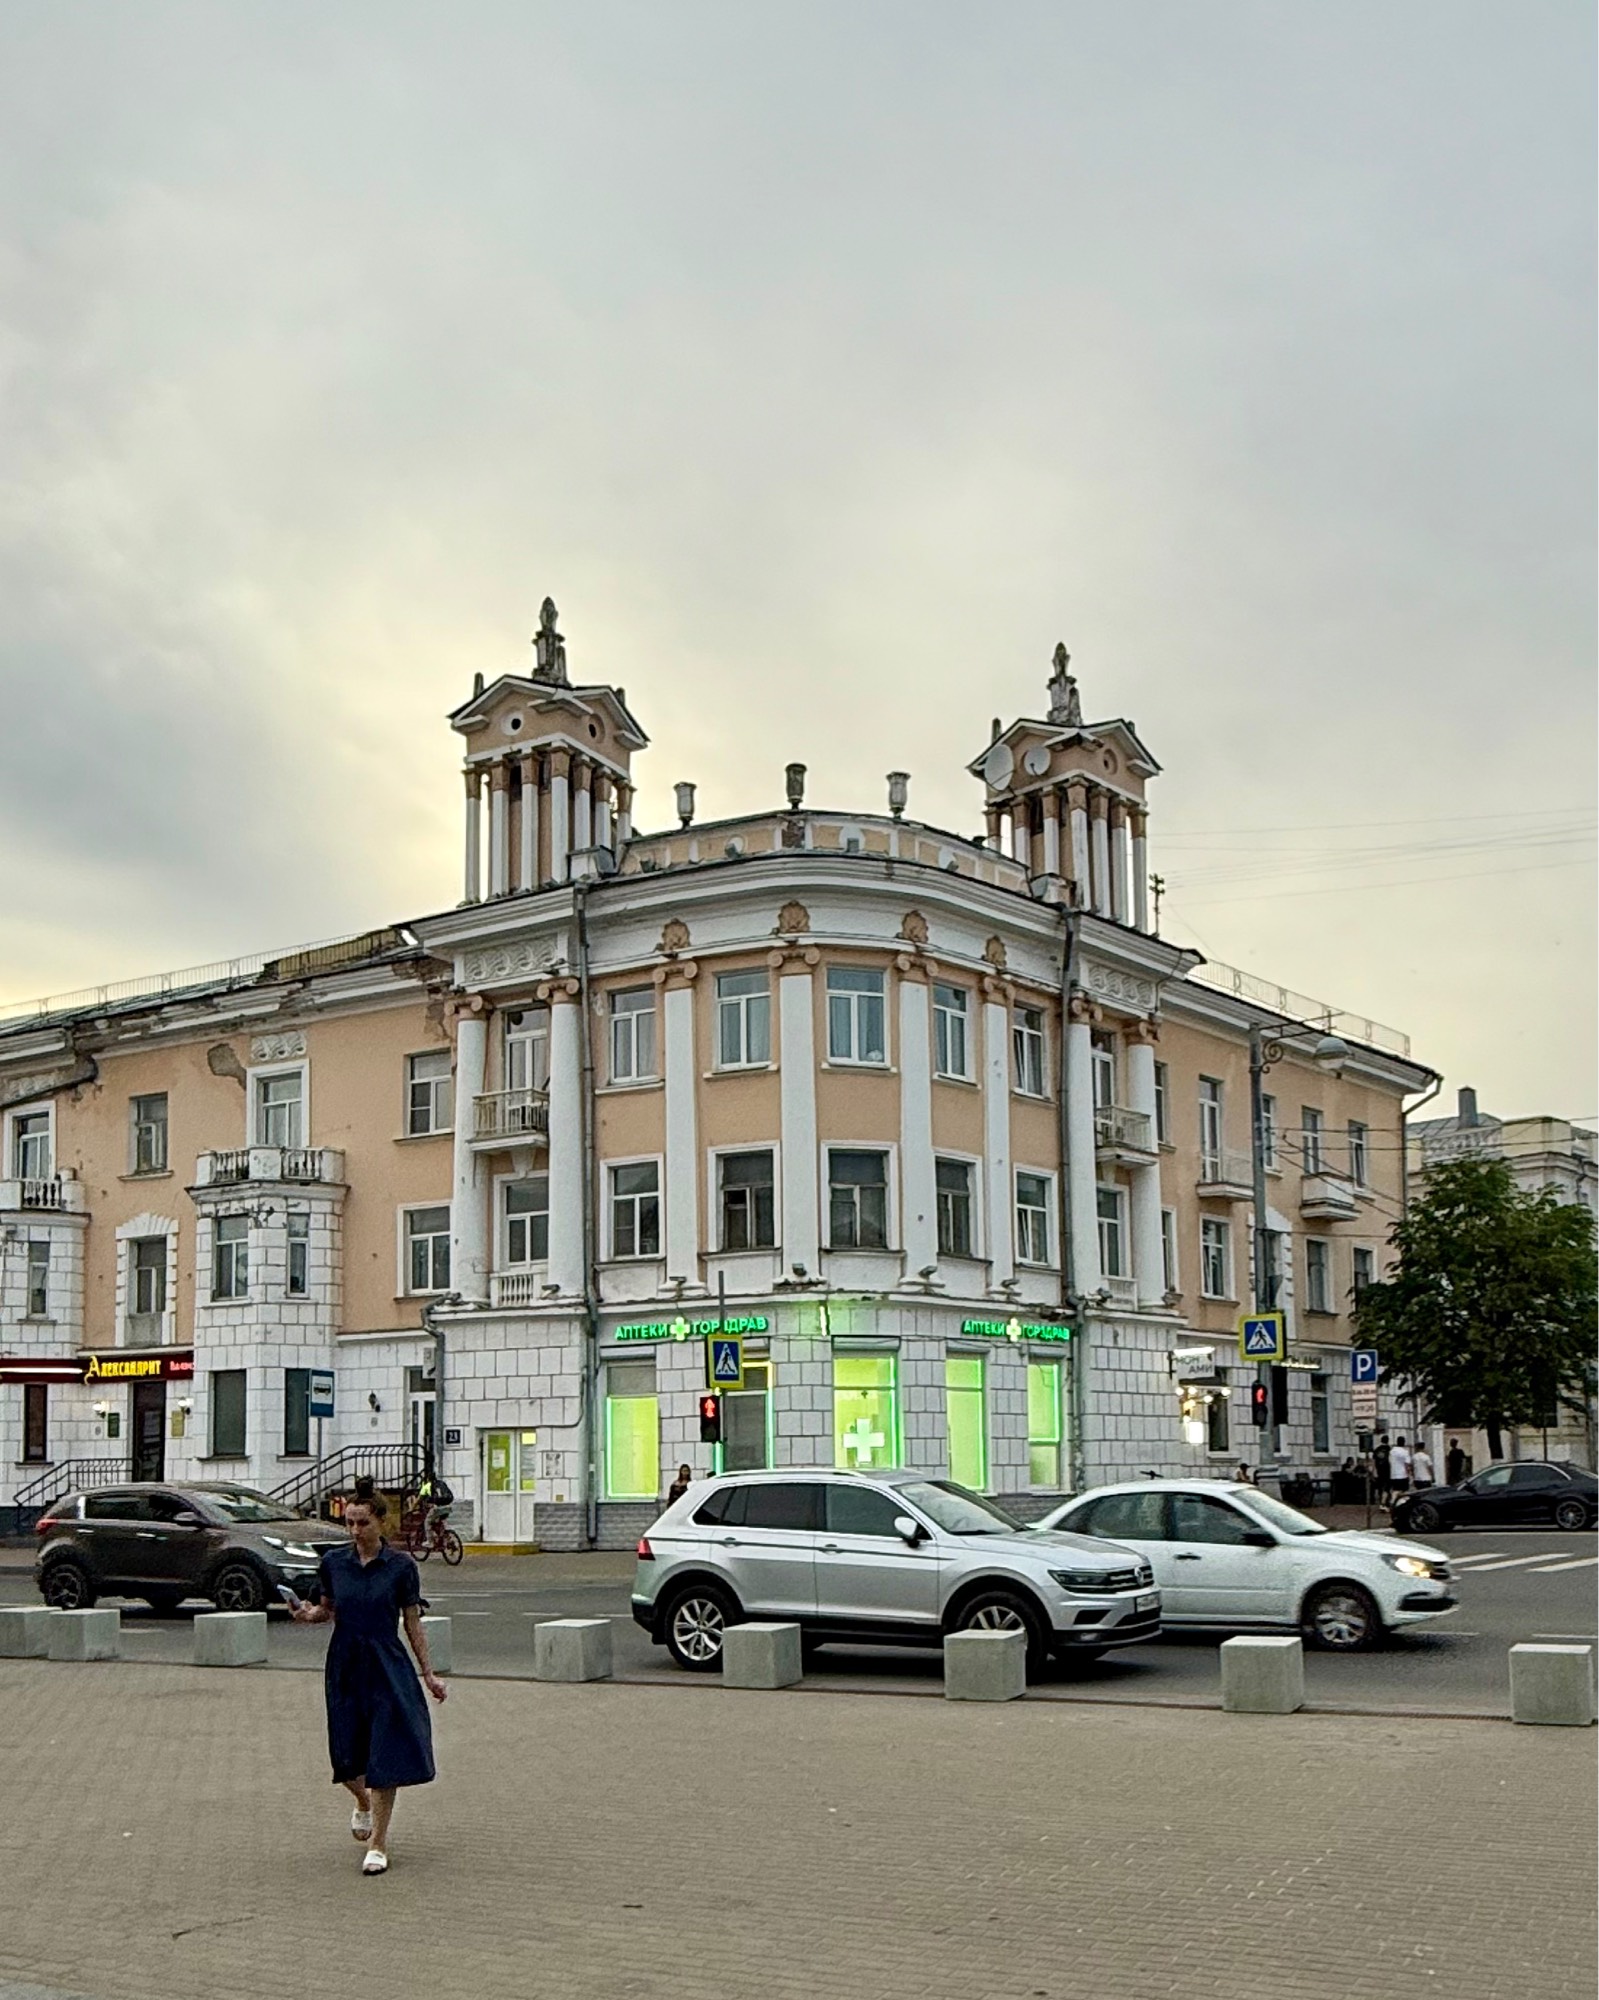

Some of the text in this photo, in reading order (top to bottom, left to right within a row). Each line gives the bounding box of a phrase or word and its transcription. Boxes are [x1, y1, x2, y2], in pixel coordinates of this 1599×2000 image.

[615, 1323, 668, 1340] АПТЕКИ
[963, 1320, 1071, 1341] АПТЕКИ ГОРЗДРАВ
[1356, 1354, 1372, 1380] P
